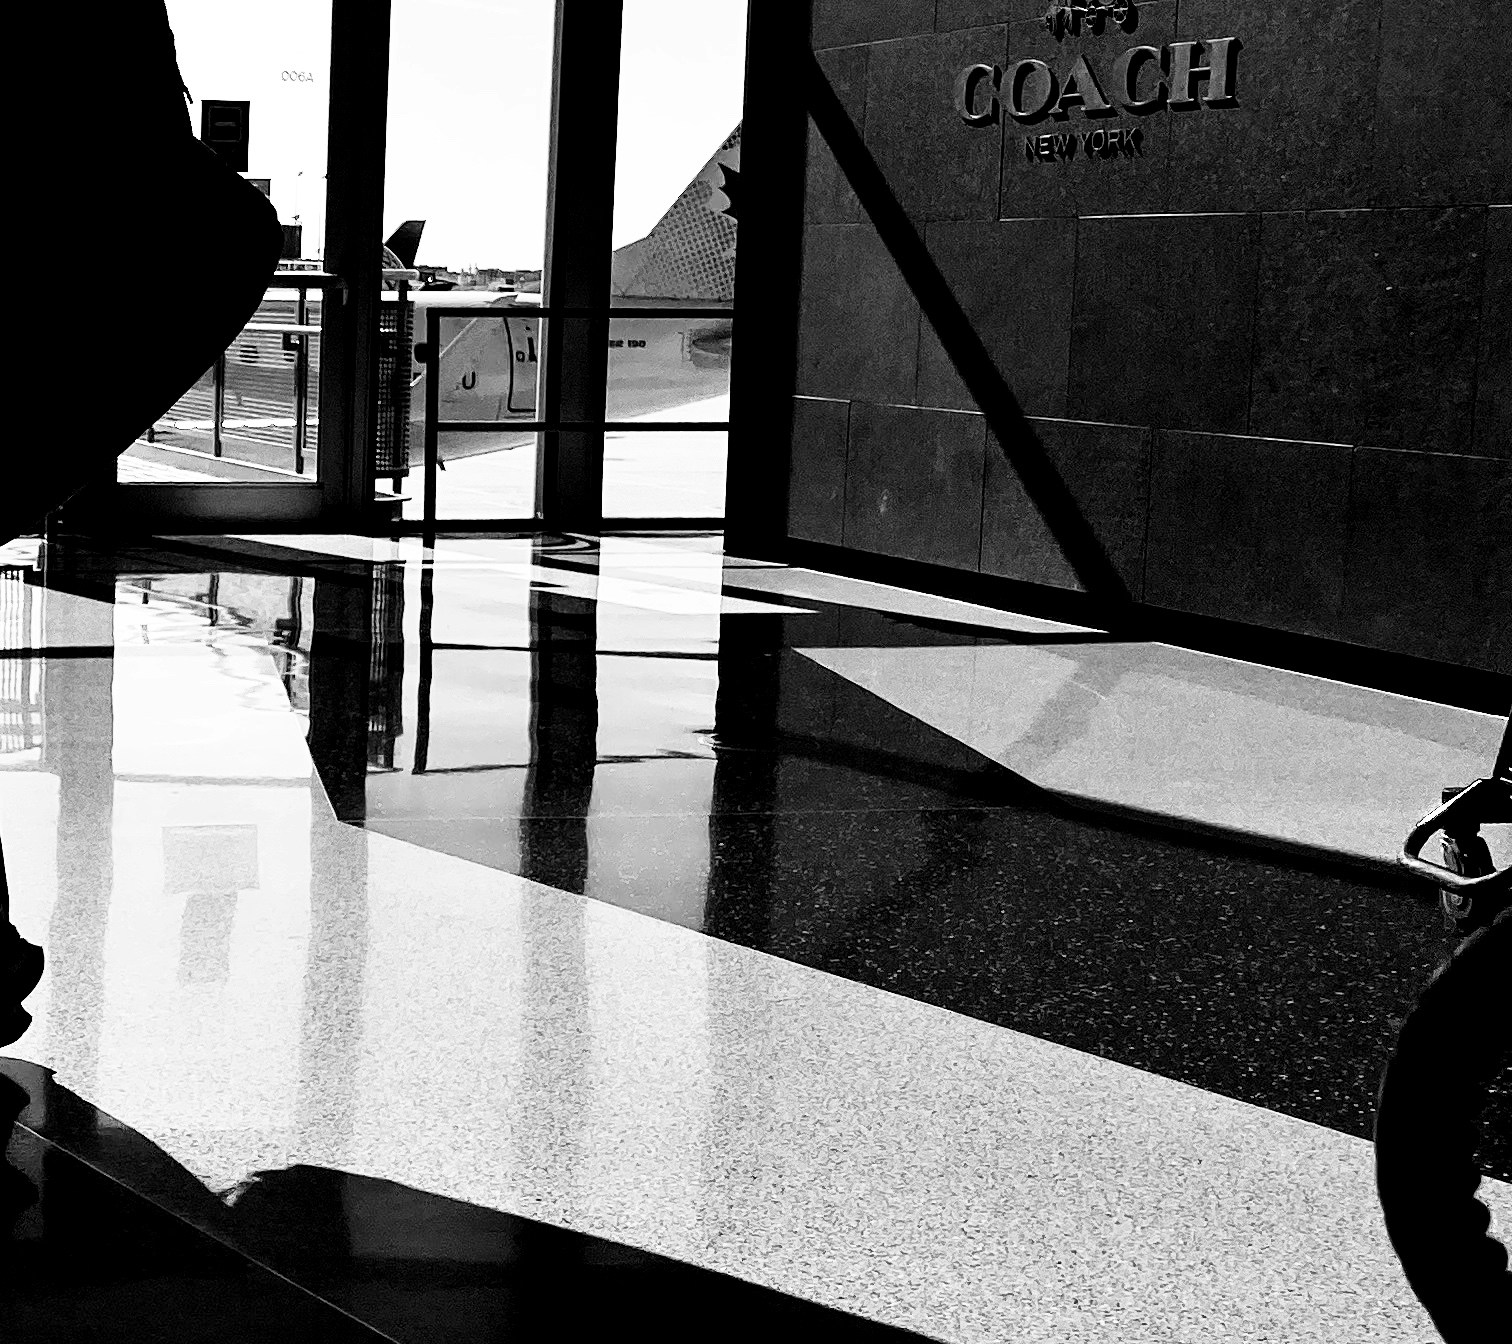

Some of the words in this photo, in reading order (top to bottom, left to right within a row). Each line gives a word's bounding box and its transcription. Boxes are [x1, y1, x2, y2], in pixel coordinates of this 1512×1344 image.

[955, 37, 1242, 126] COACH
[1024, 133, 1076, 161] NEW
[1079, 126, 1143, 157] YORK
